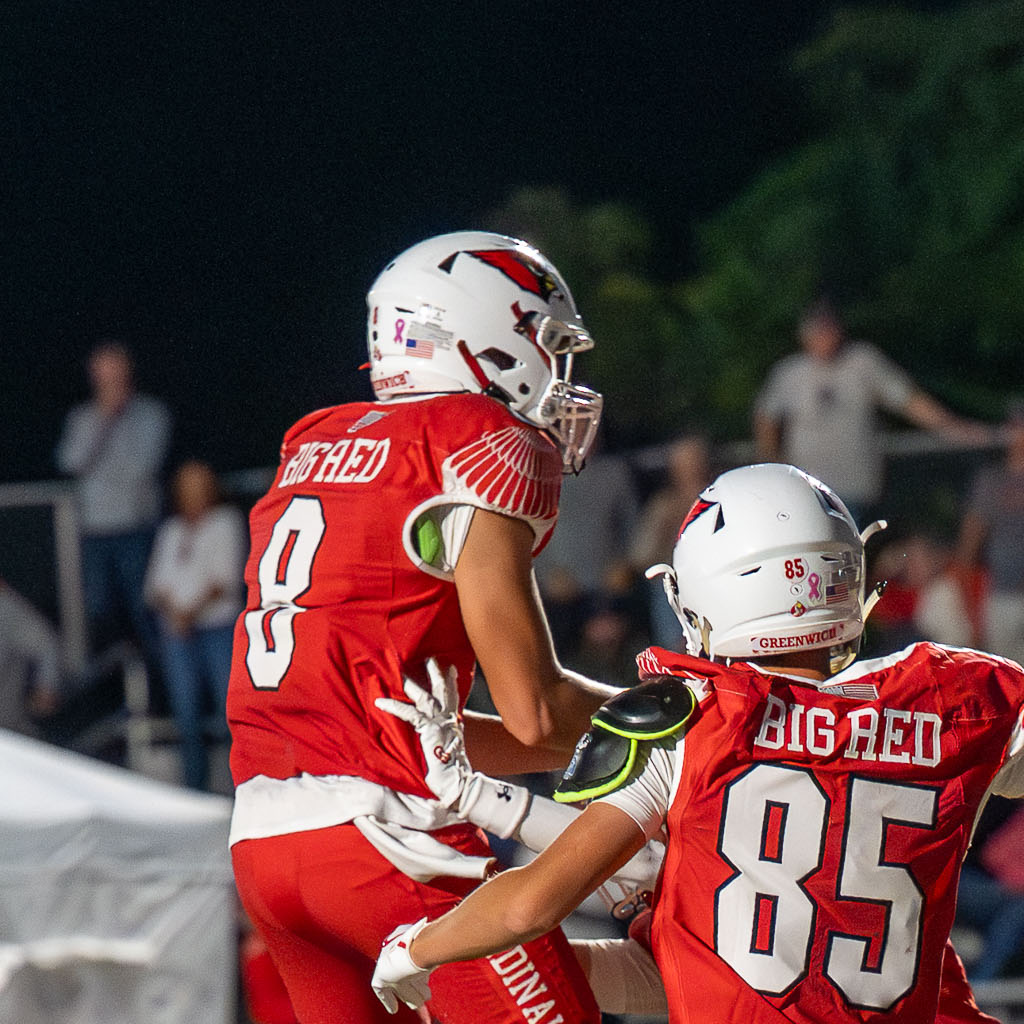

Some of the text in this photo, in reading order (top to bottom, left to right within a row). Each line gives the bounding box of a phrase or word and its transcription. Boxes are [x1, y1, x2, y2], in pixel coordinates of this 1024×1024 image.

[278, 437, 392, 489] BIG RED
[244, 494, 327, 692] 8
[784, 558, 805, 580] 85
[759, 627, 837, 649] GREENWICH
[753, 693, 944, 768] BIG RED
[713, 761, 941, 1014] 85
